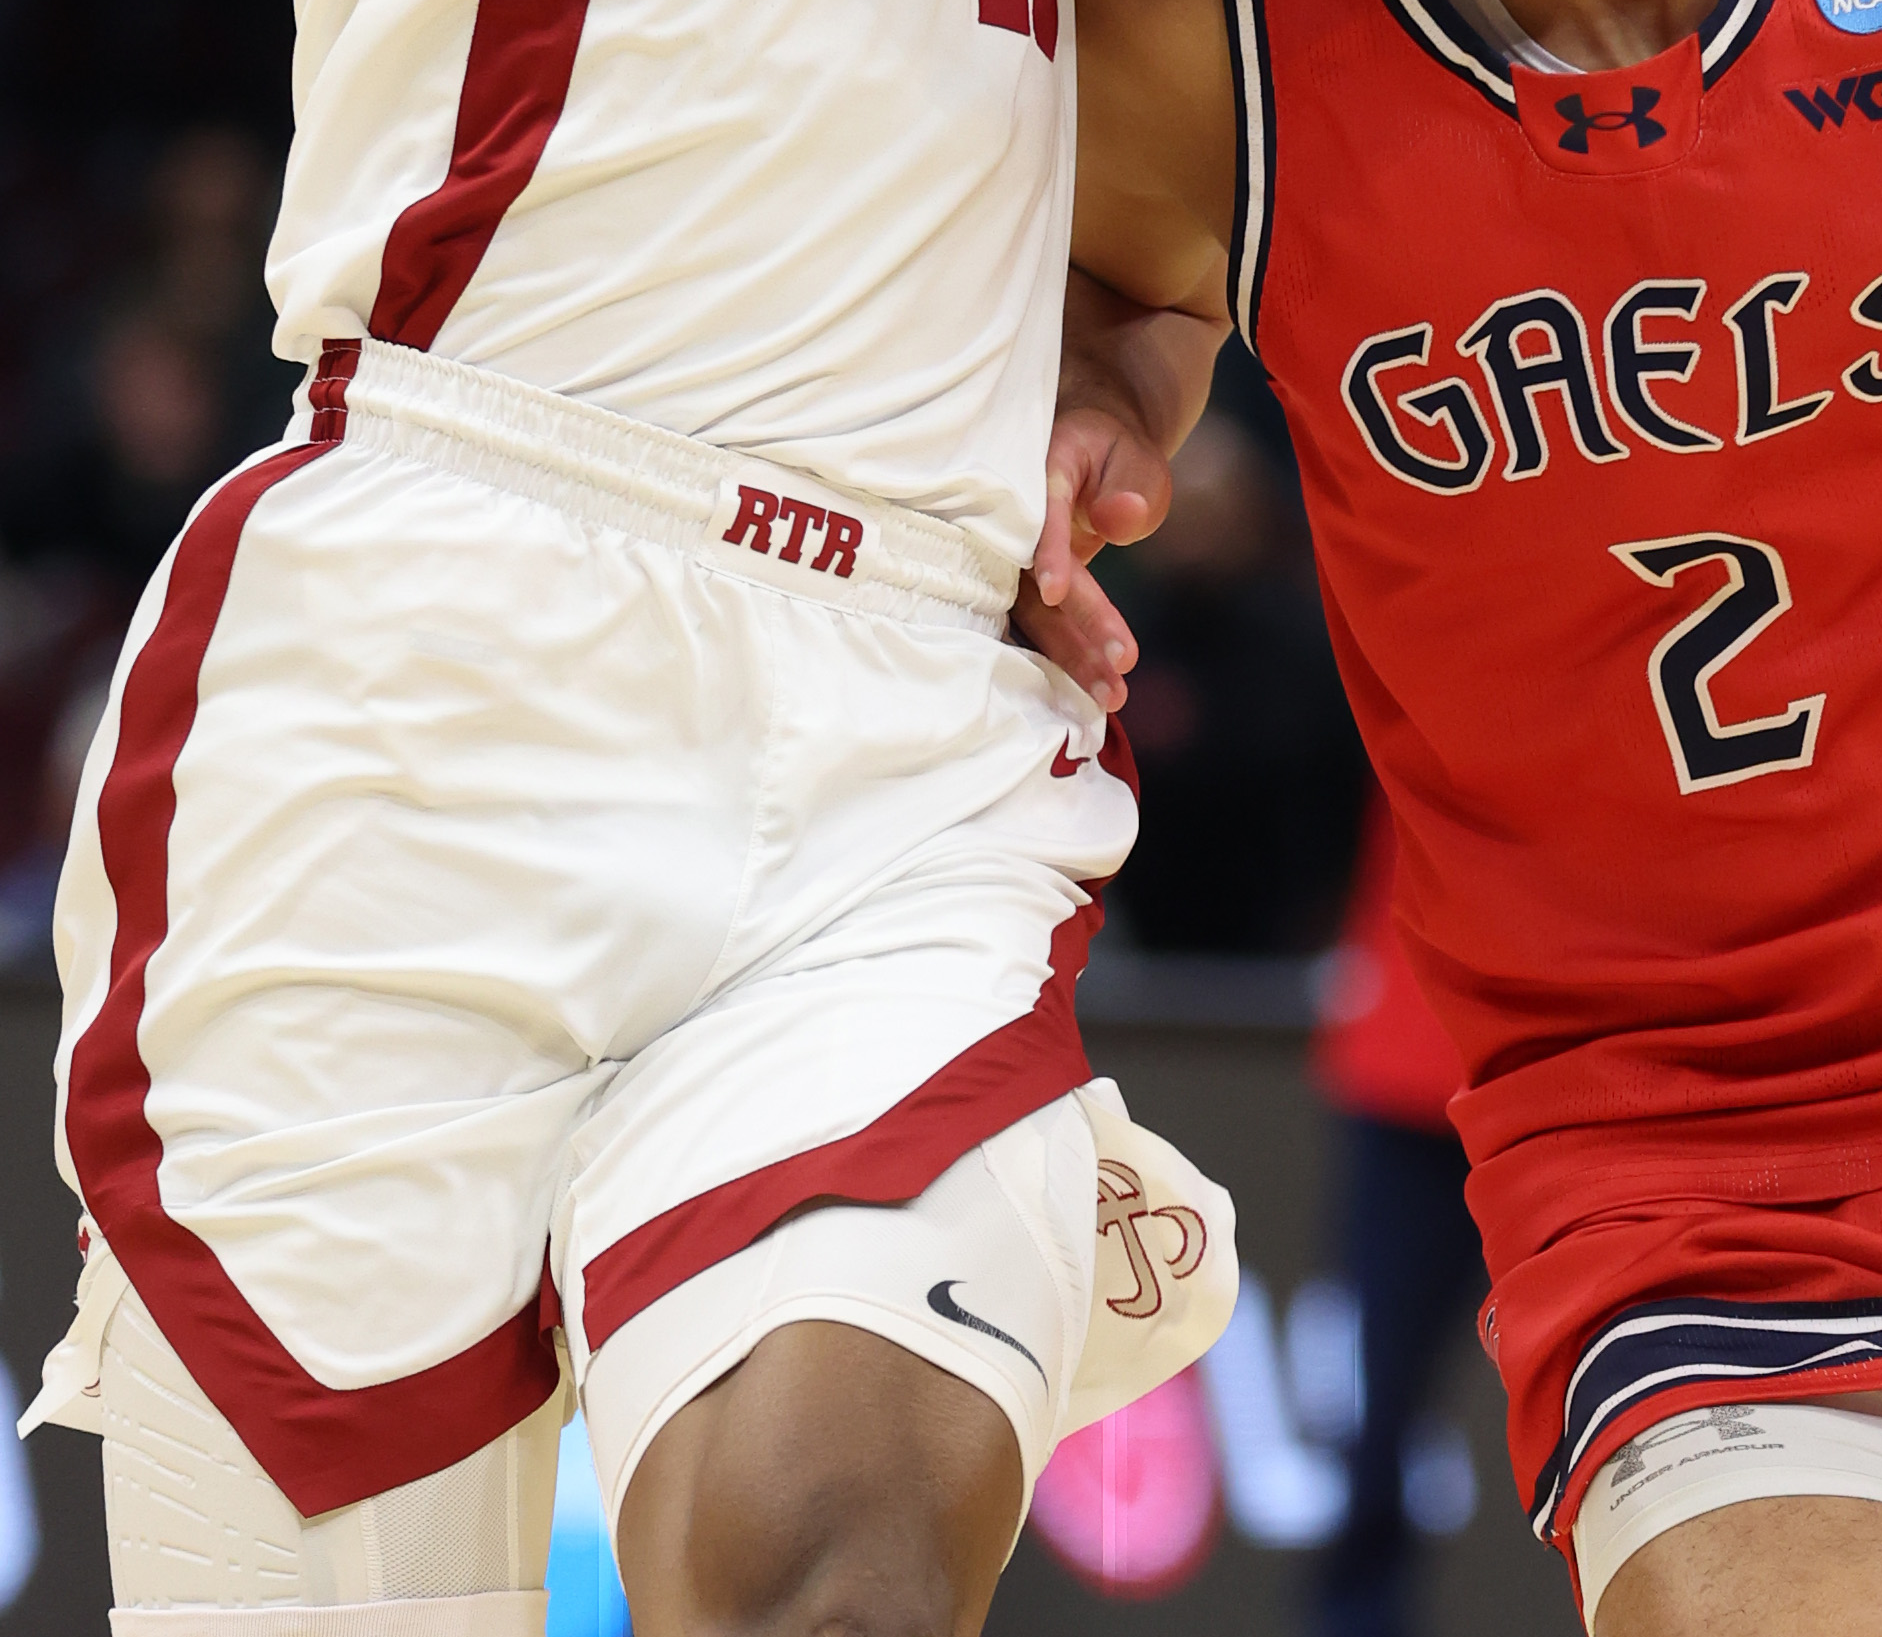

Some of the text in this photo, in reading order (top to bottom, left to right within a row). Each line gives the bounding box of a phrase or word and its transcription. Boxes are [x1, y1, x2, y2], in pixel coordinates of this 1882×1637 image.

[722, 484, 864, 579] RTR
[1608, 531, 1826, 796] 2
[1609, 1442, 1785, 1512] UNDER ARMOUR
